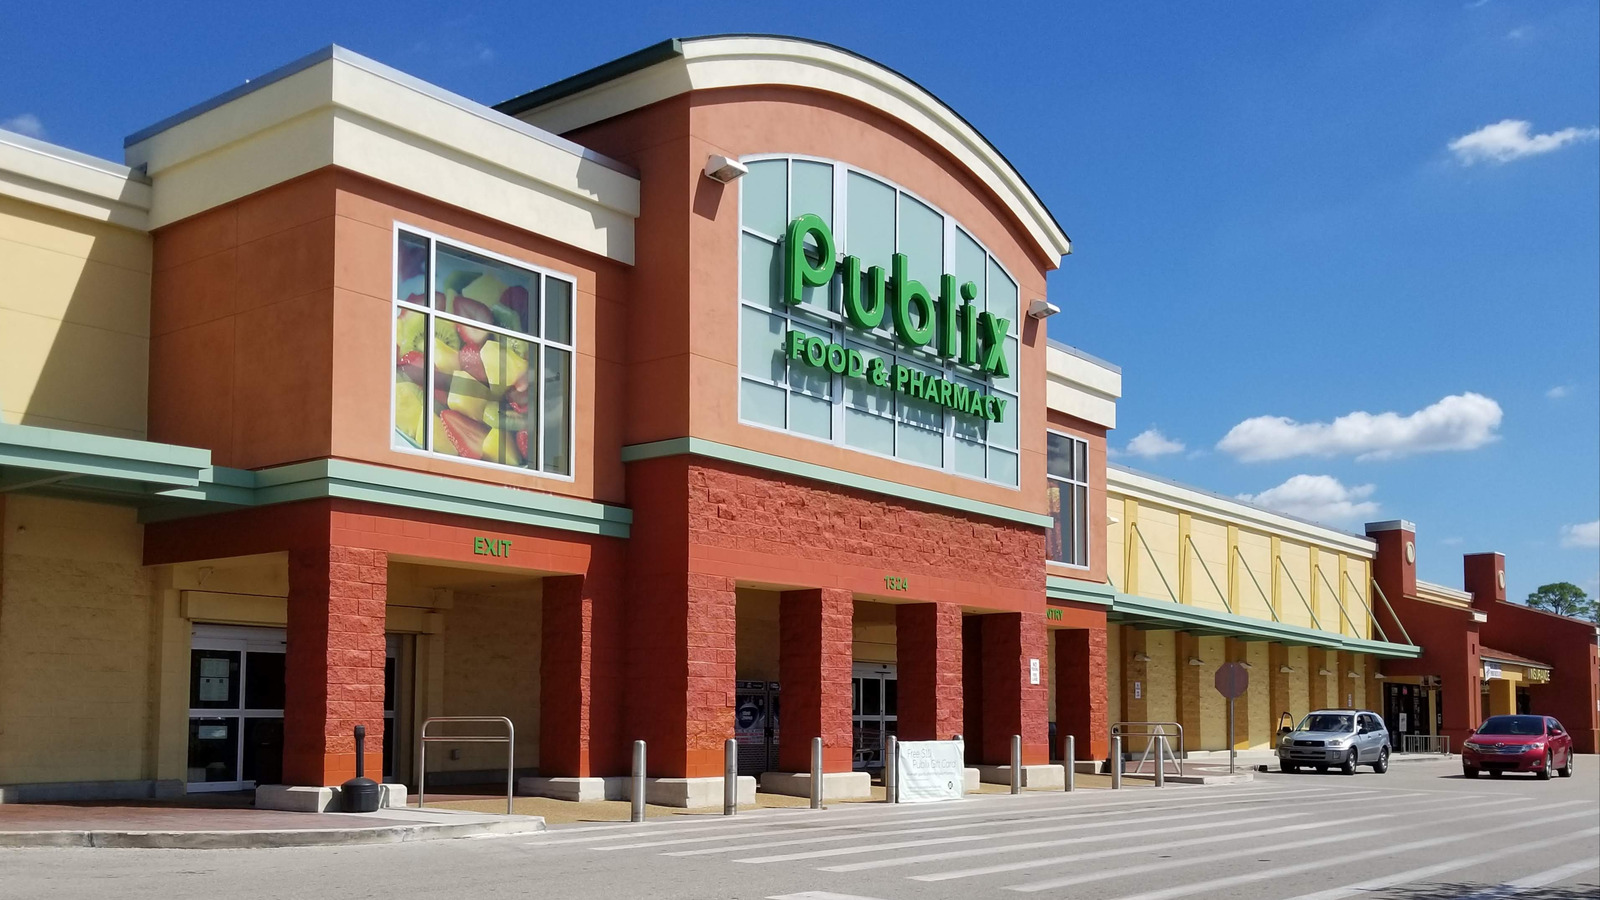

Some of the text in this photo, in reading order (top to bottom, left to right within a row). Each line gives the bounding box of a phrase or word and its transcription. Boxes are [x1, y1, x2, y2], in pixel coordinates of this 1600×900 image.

[784, 213, 1010, 379] Publix
[787, 330, 1007, 423] FOOD & PHARMACY
[474, 536, 512, 558] EXIT
[884, 575, 908, 592] 1324
[1046, 608, 1064, 621] NTRY
[907, 748, 920, 759] Free
